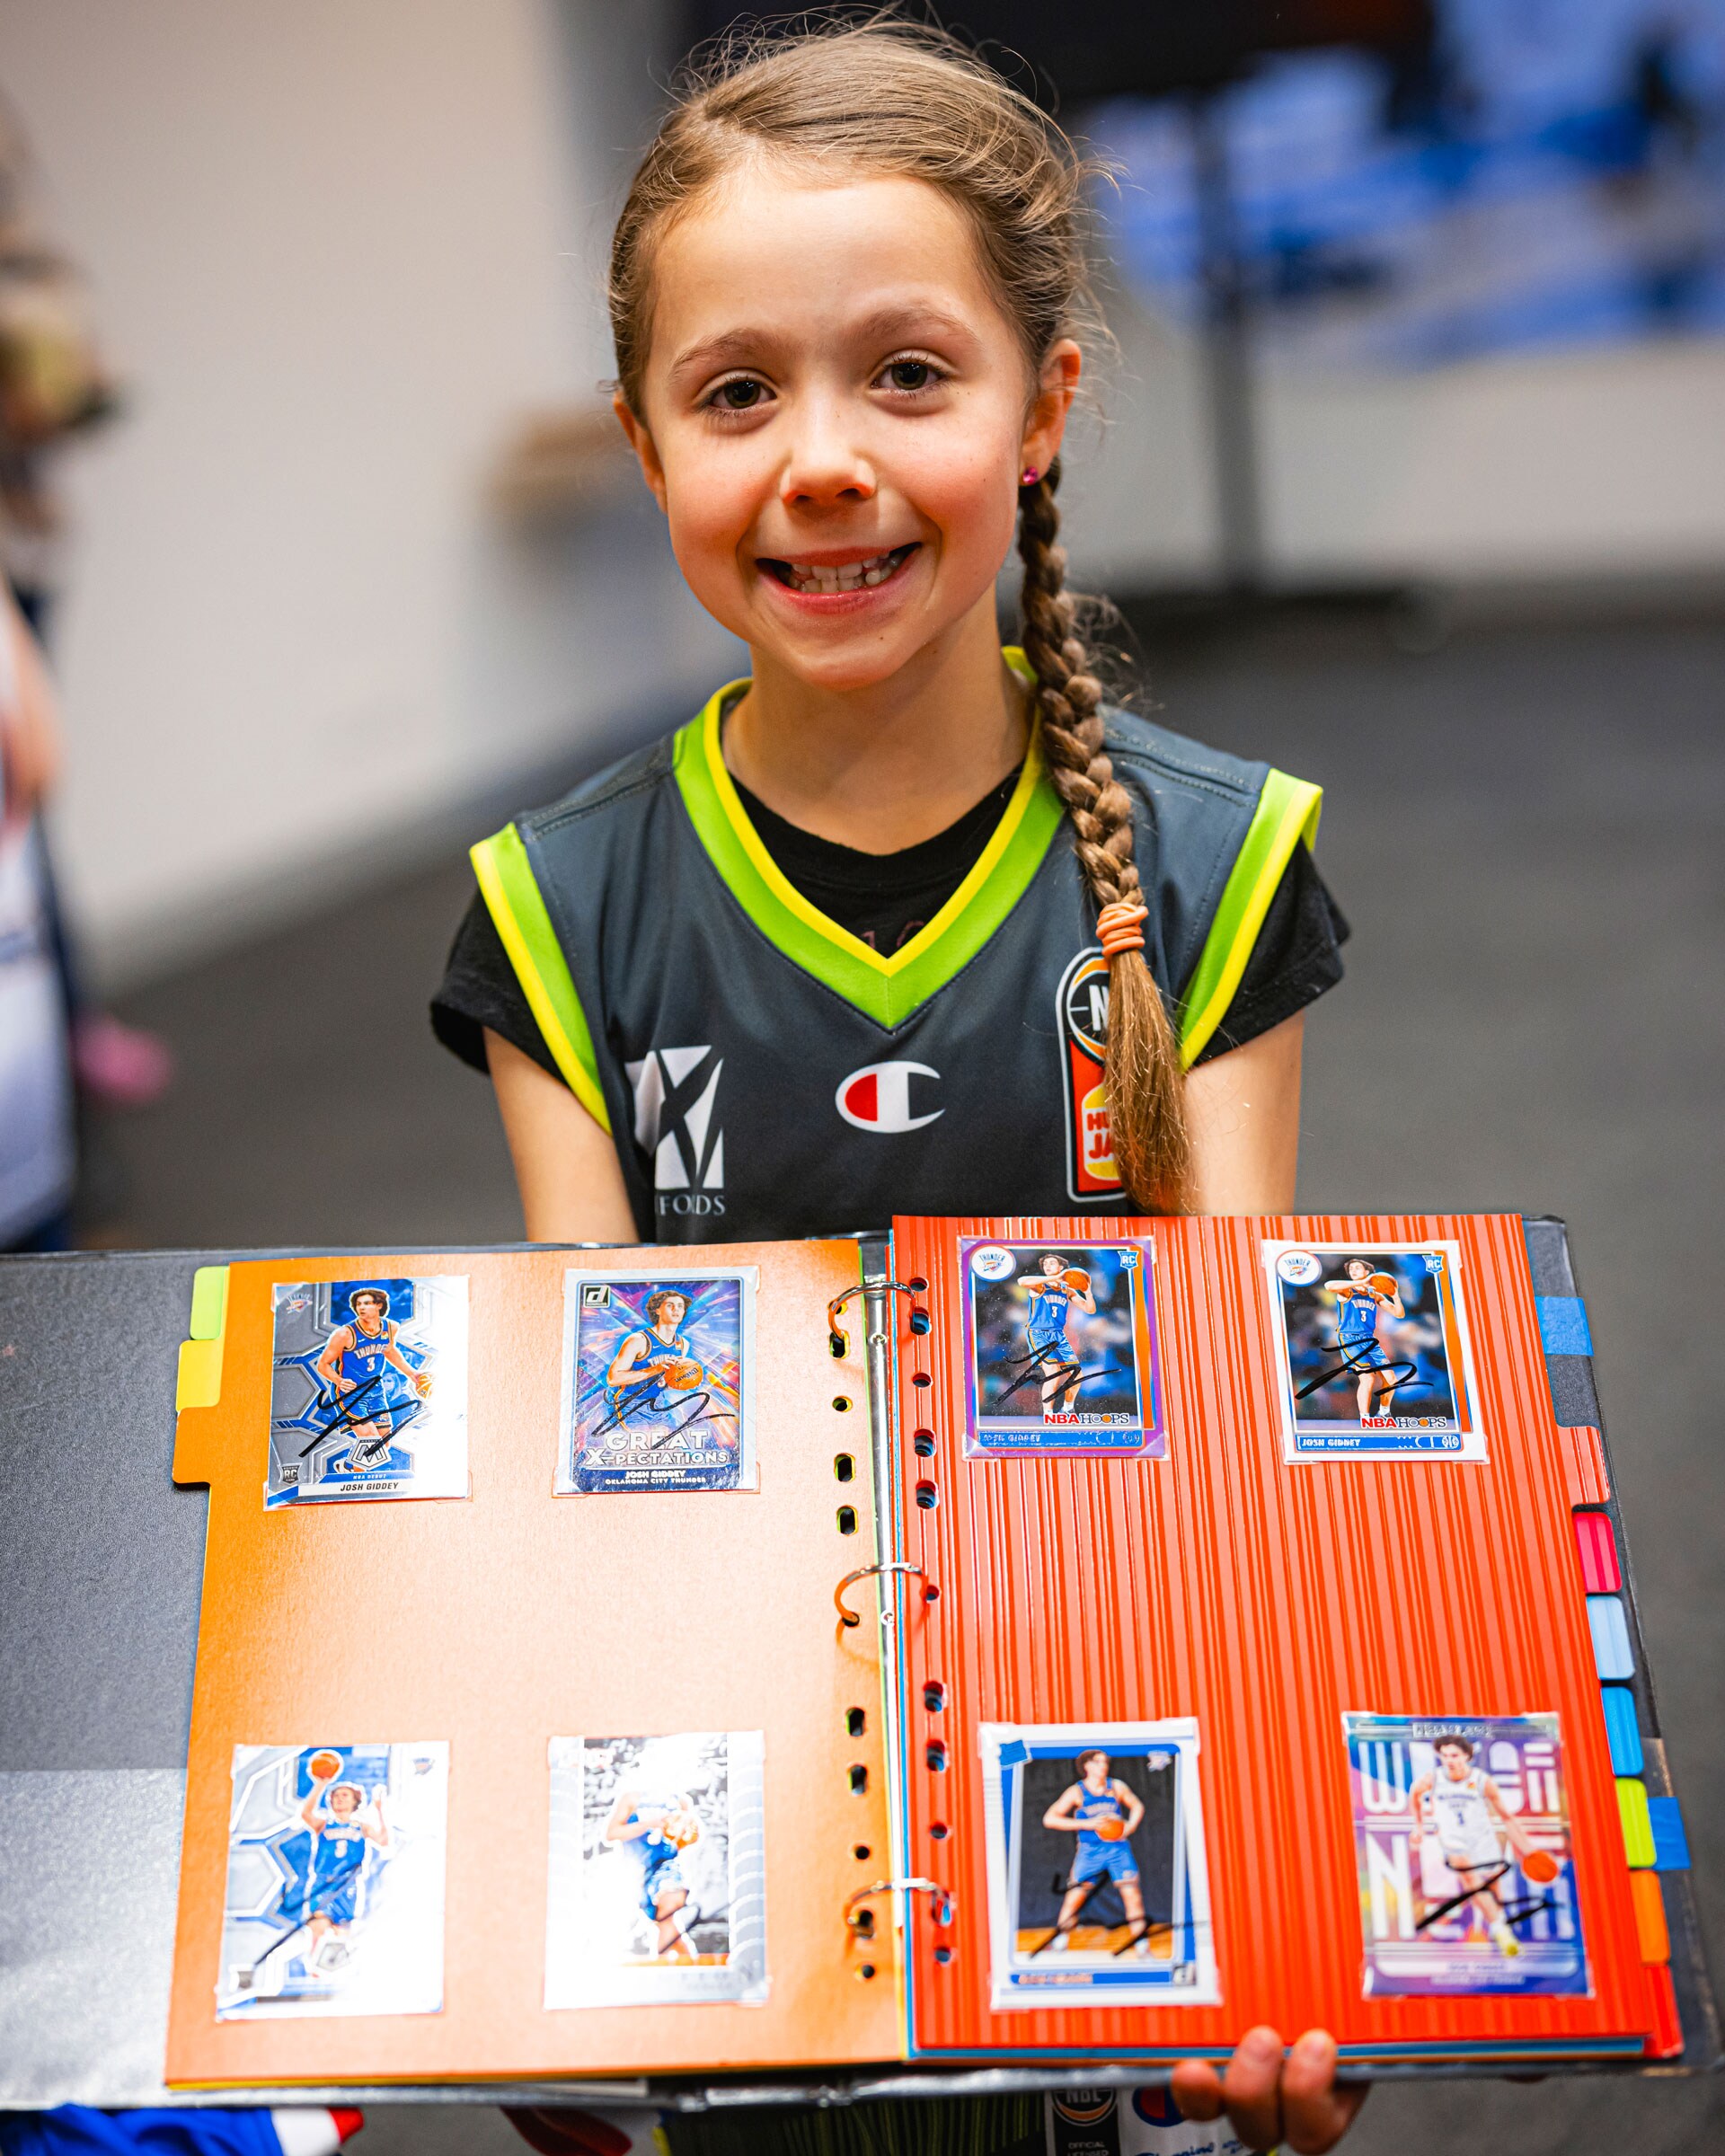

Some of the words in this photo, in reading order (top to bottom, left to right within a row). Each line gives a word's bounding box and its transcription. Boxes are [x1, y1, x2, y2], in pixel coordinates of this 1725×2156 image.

[1123, 1256, 1136, 1264] RC
[1428, 1259, 1440, 1268] RC
[1051, 1306, 1058, 1318] 3
[1360, 1311, 1367, 1322] 3
[367, 1356, 376, 1372] 3
[606, 1430, 708, 1451] GREAT
[1328, 1438, 1361, 1446] GIDDEY
[586, 1448, 729, 1466] X-PECTATIONS
[284, 1469, 297, 1479] RC
[624, 1471, 650, 1480] JOSH
[650, 1470, 686, 1479] GIDDEY
[341, 1483, 364, 1492] JOSH
[367, 1482, 399, 1491] GIDDEY
